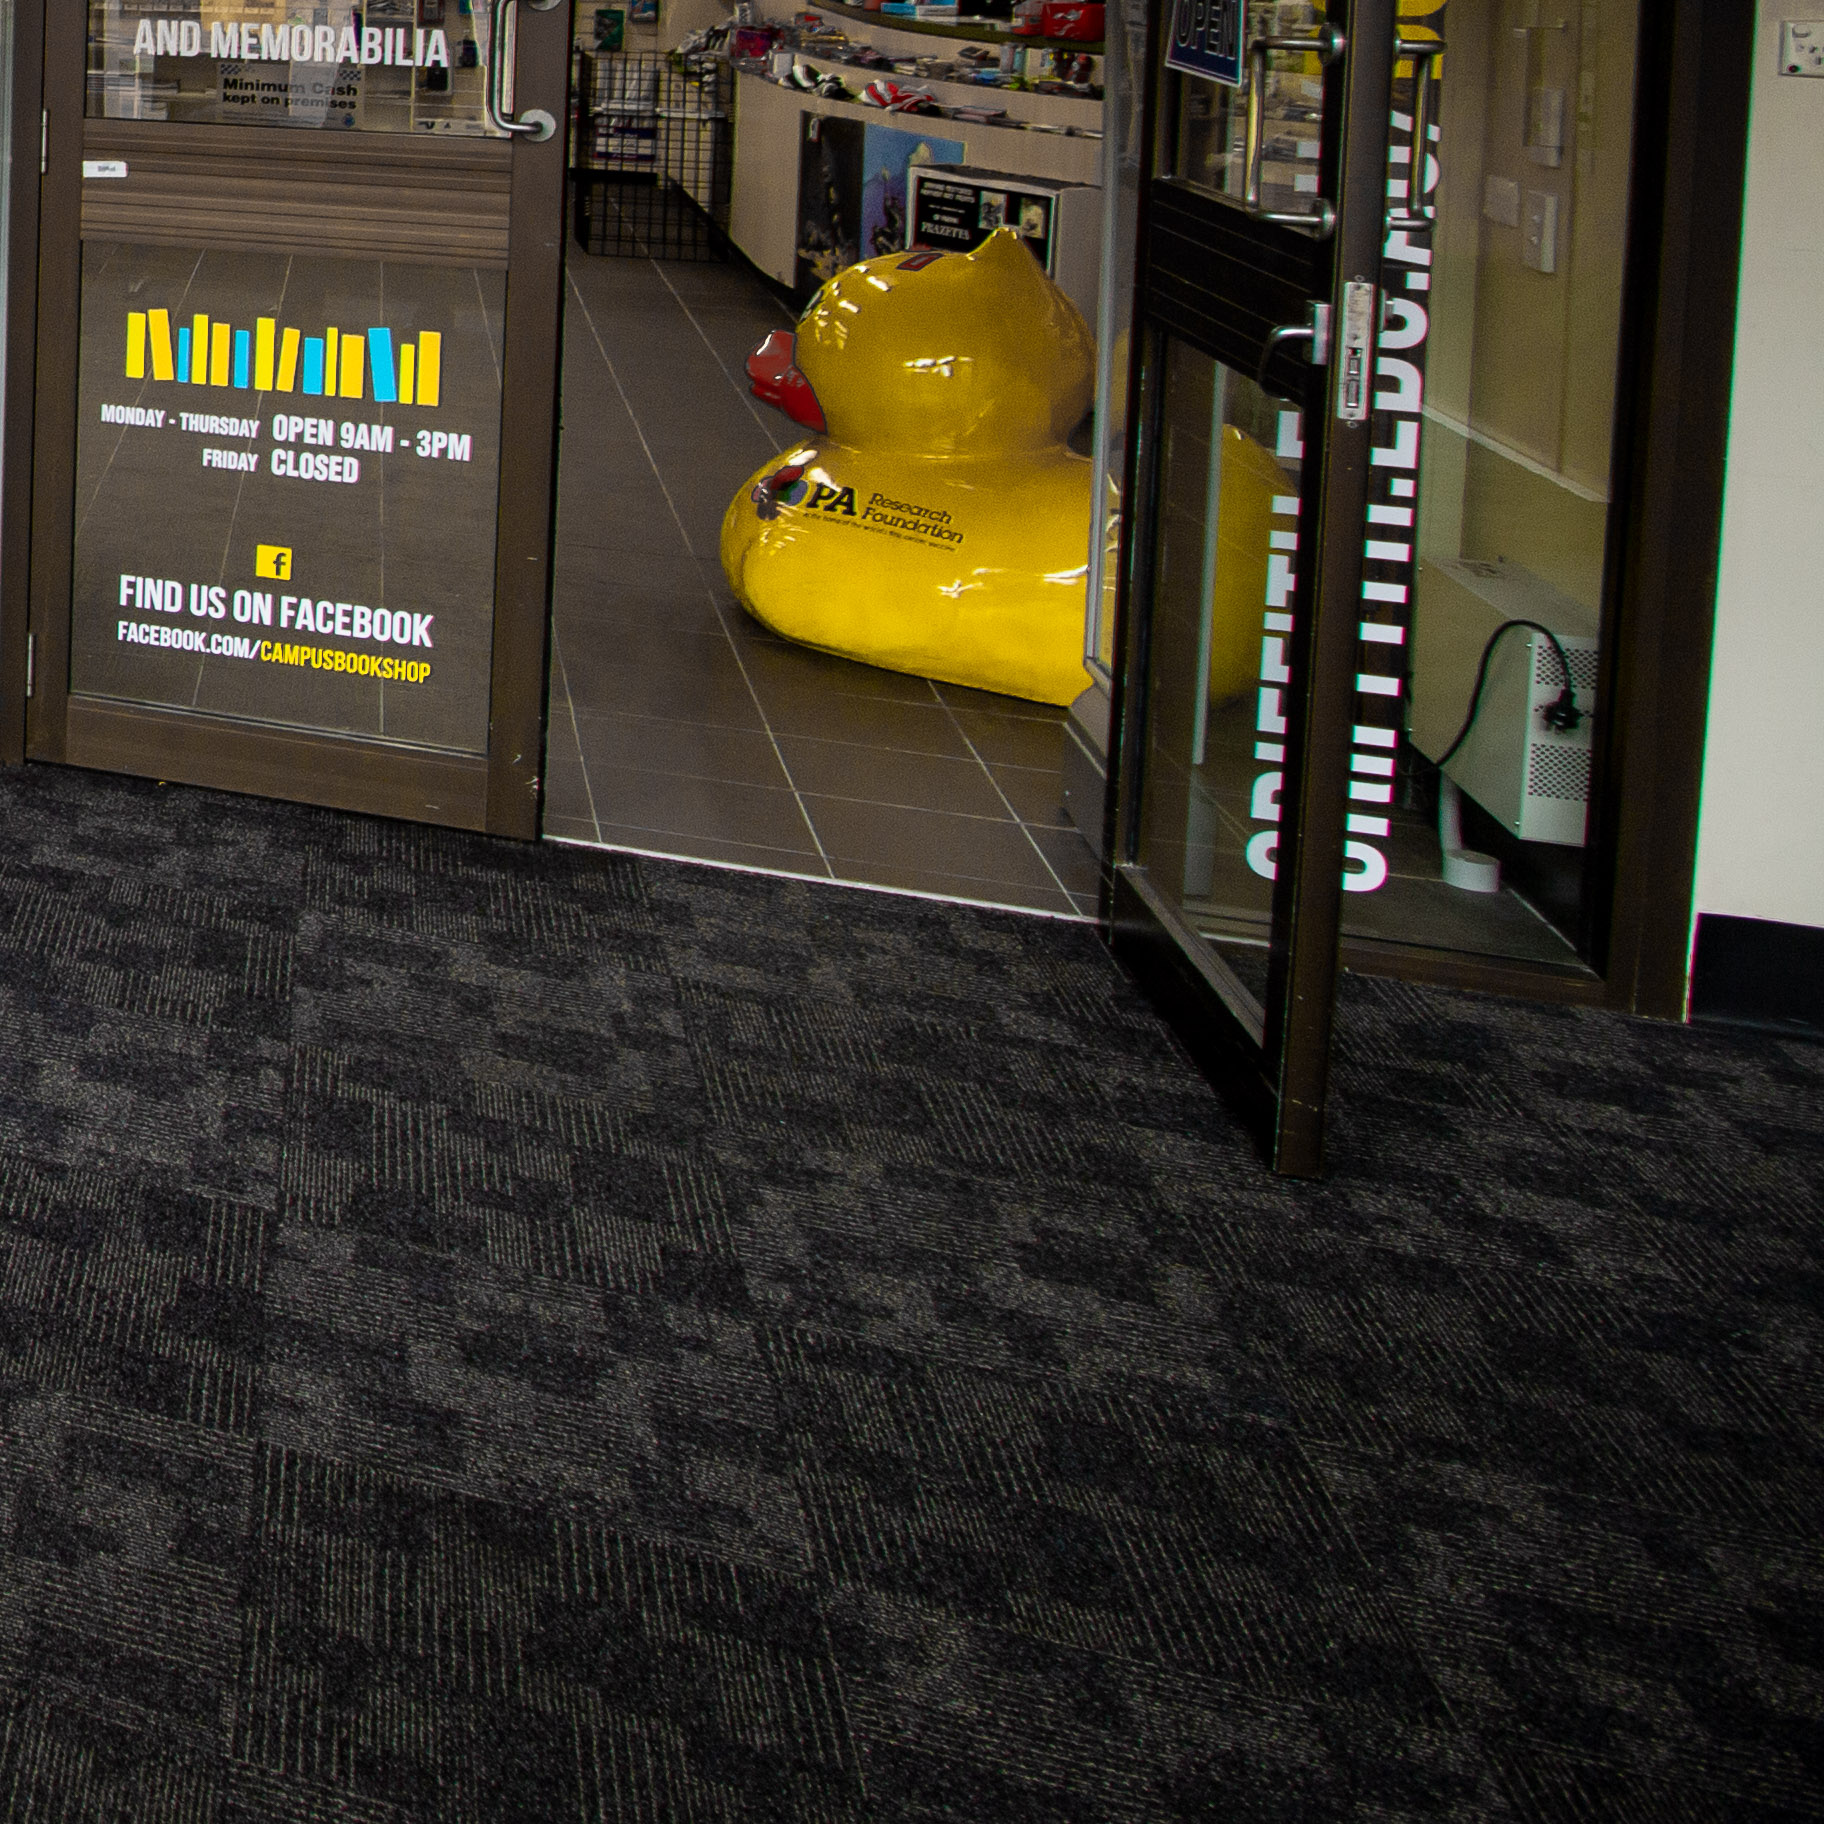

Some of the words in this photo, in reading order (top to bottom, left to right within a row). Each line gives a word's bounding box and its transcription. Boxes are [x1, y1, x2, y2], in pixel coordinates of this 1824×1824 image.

[134, 17, 202, 57] AND
[210, 21, 450, 67] MEMORABILIA
[222, 77, 306, 96] Minimum
[311, 81, 359, 97] Cash
[222, 91, 257, 107] kept
[260, 94, 281, 106] on
[283, 95, 357, 111] premises
[100, 403, 165, 429] MONDAY
[179, 410, 261, 439] THURSDAY
[271, 413, 334, 447] OPEN
[339, 419, 393, 454] 9AM
[415, 430, 471, 463] 3PM
[202, 447, 259, 473] FRIDAY
[270, 448, 360, 484] CLOSED
[805, 481, 858, 517] PA
[868, 491, 953, 525] Research
[860, 506, 965, 545] Foundation
[119, 573, 183, 614] FIND
[188, 584, 227, 619] US
[232, 589, 273, 626] ON
[278, 594, 434, 648] FACEBOOK
[116, 620, 432, 685] FACEBOOK.COM/CAMPUSBOOKSHOP
